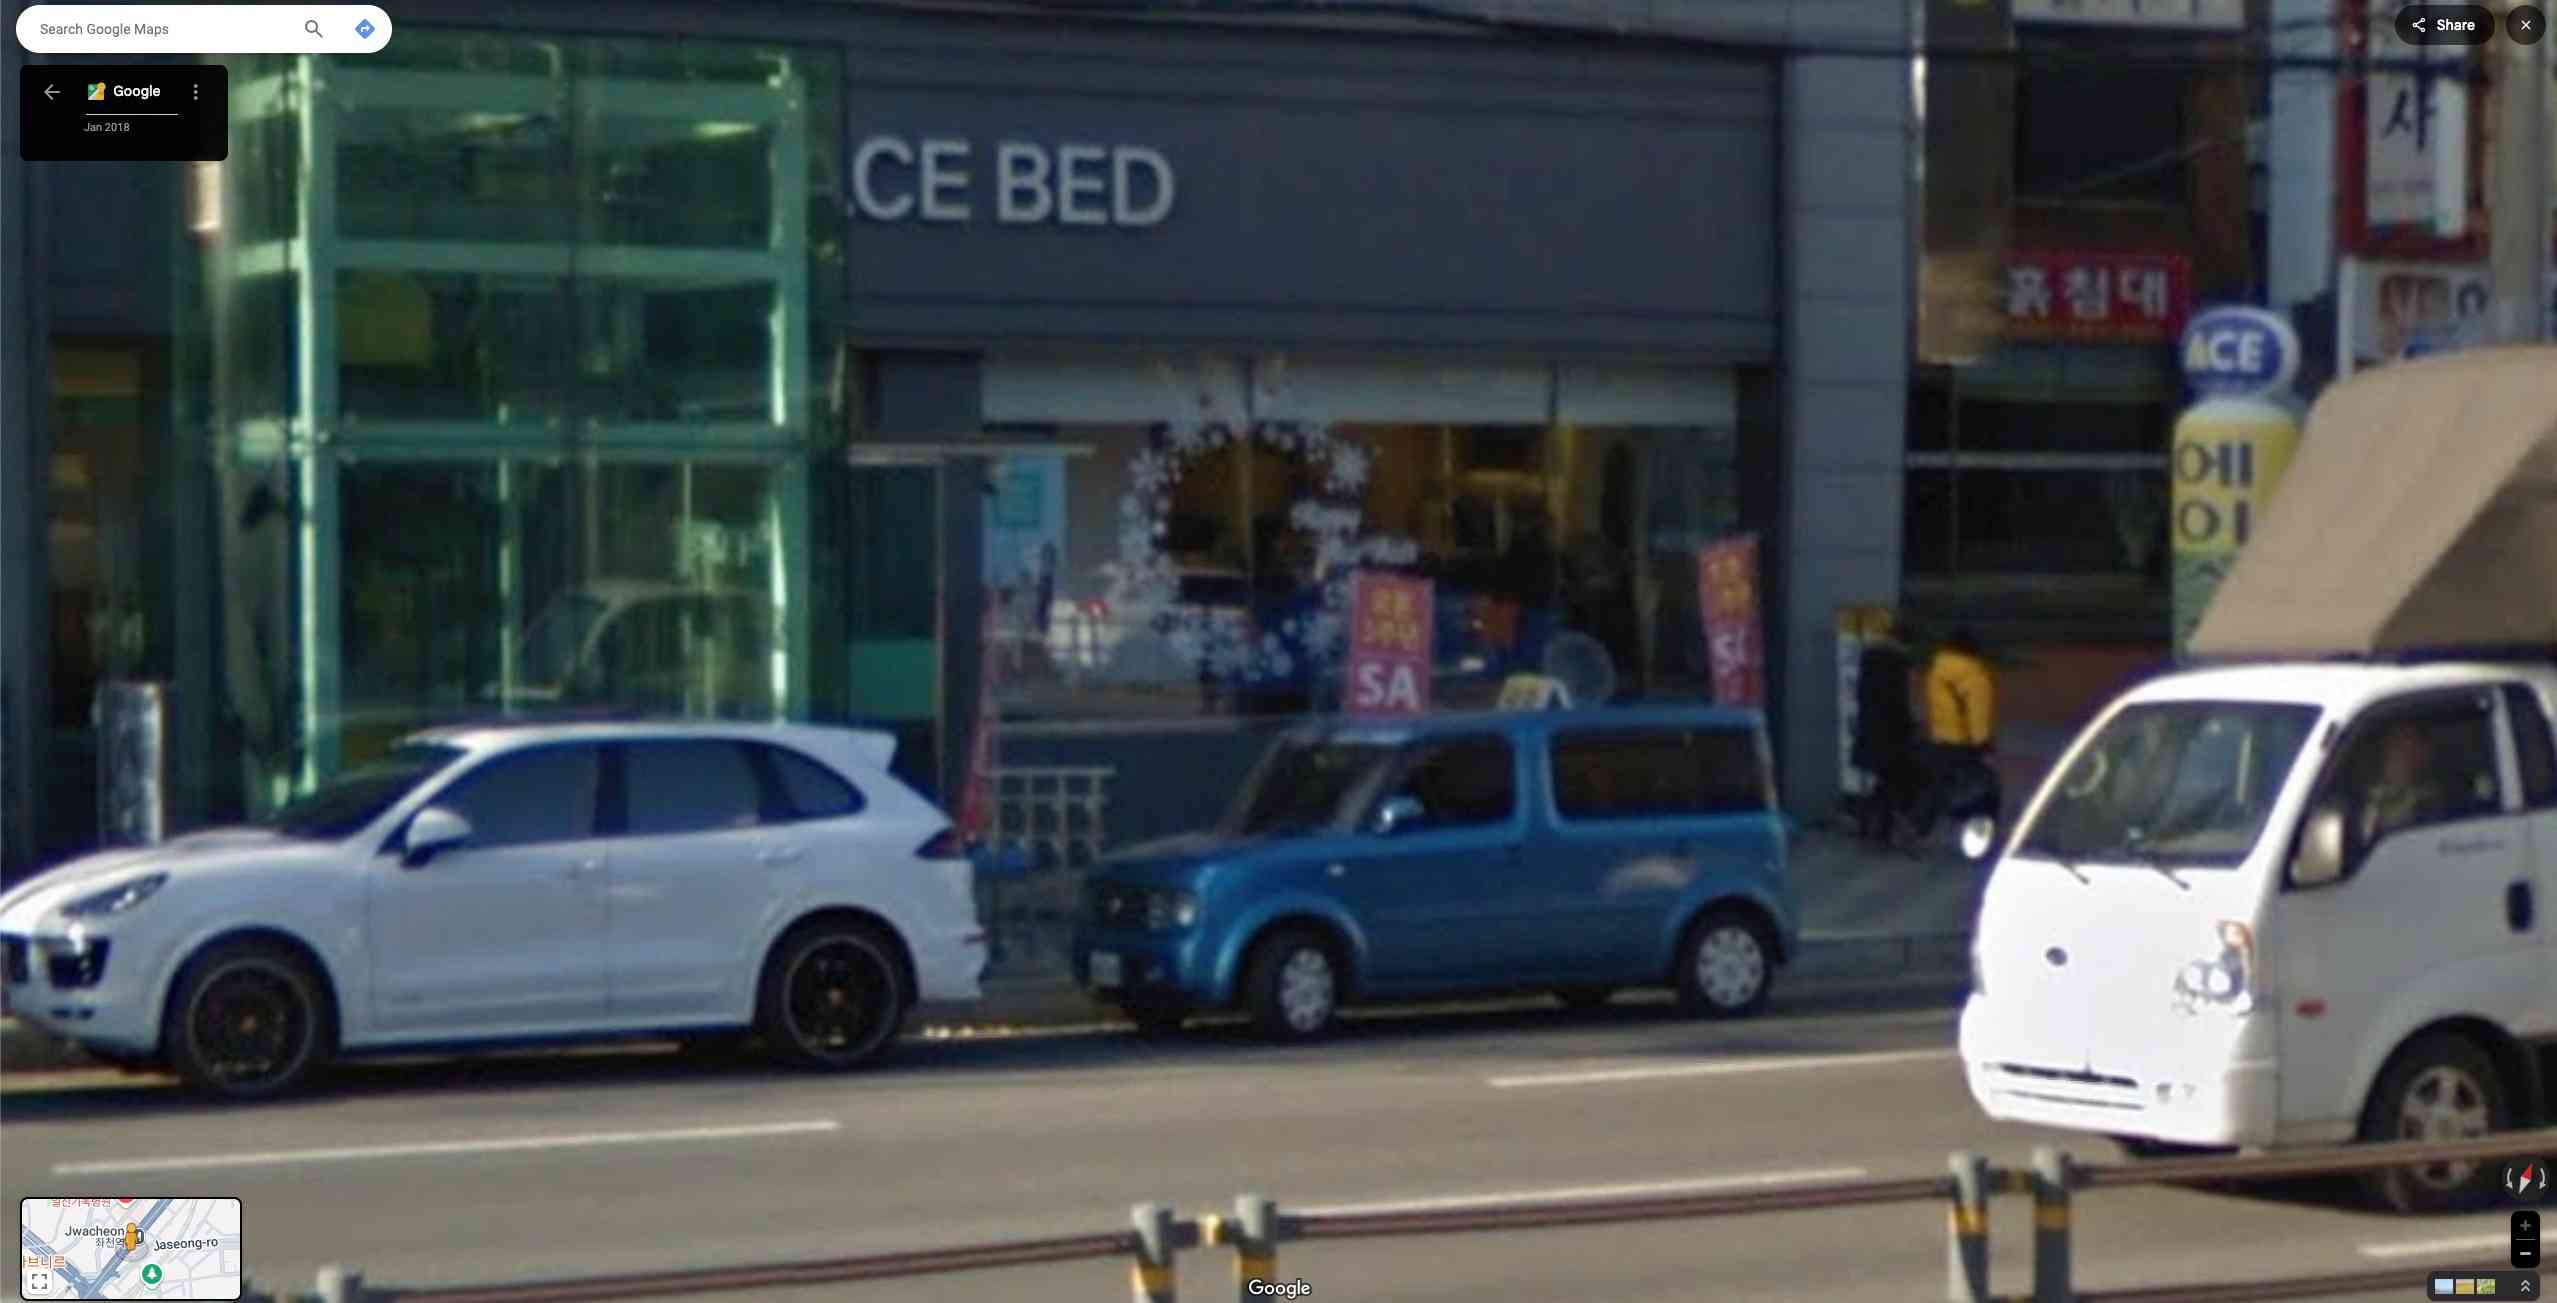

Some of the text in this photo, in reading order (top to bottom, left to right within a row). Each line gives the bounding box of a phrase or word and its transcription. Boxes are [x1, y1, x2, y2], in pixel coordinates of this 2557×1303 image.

[847, 136, 1175, 226] CE BED
[2185, 329, 2265, 373] ACE
